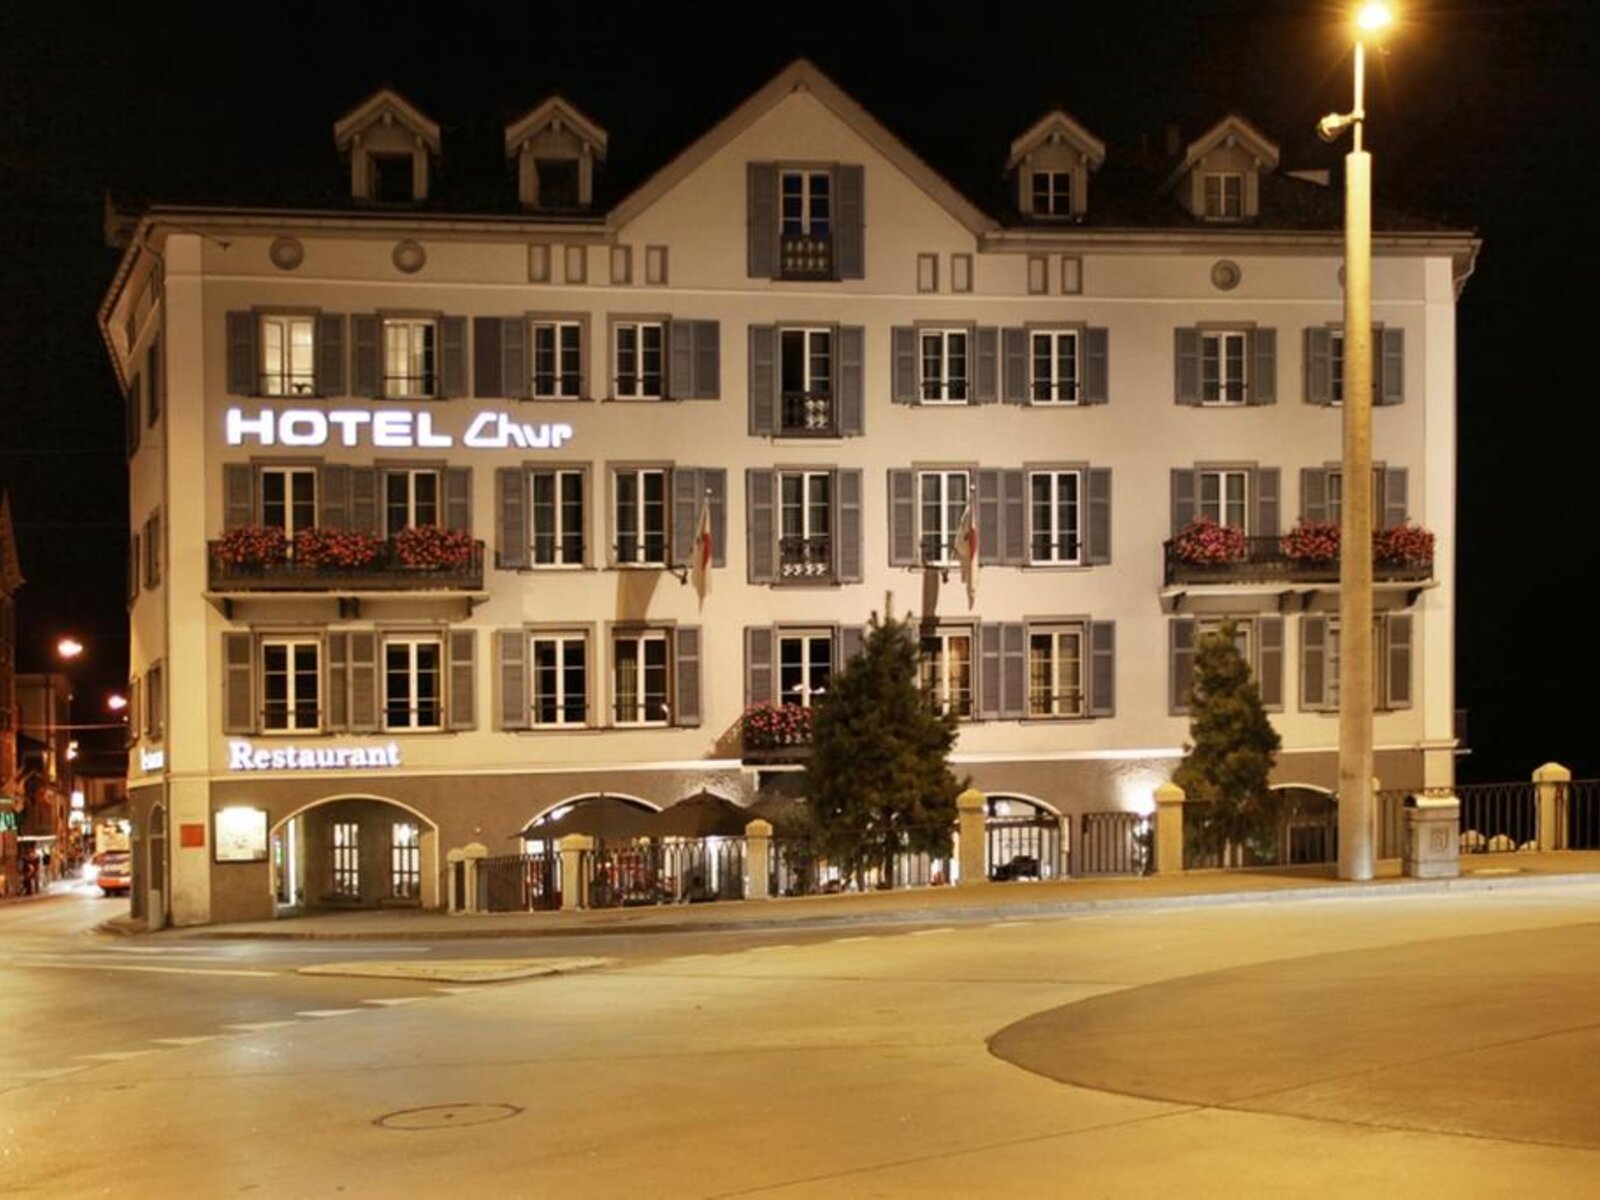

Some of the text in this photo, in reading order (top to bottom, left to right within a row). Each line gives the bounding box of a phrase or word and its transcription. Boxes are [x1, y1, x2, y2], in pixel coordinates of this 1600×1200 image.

[225, 408, 574, 448] HOTEL Chur
[228, 738, 402, 770] Restaurant
